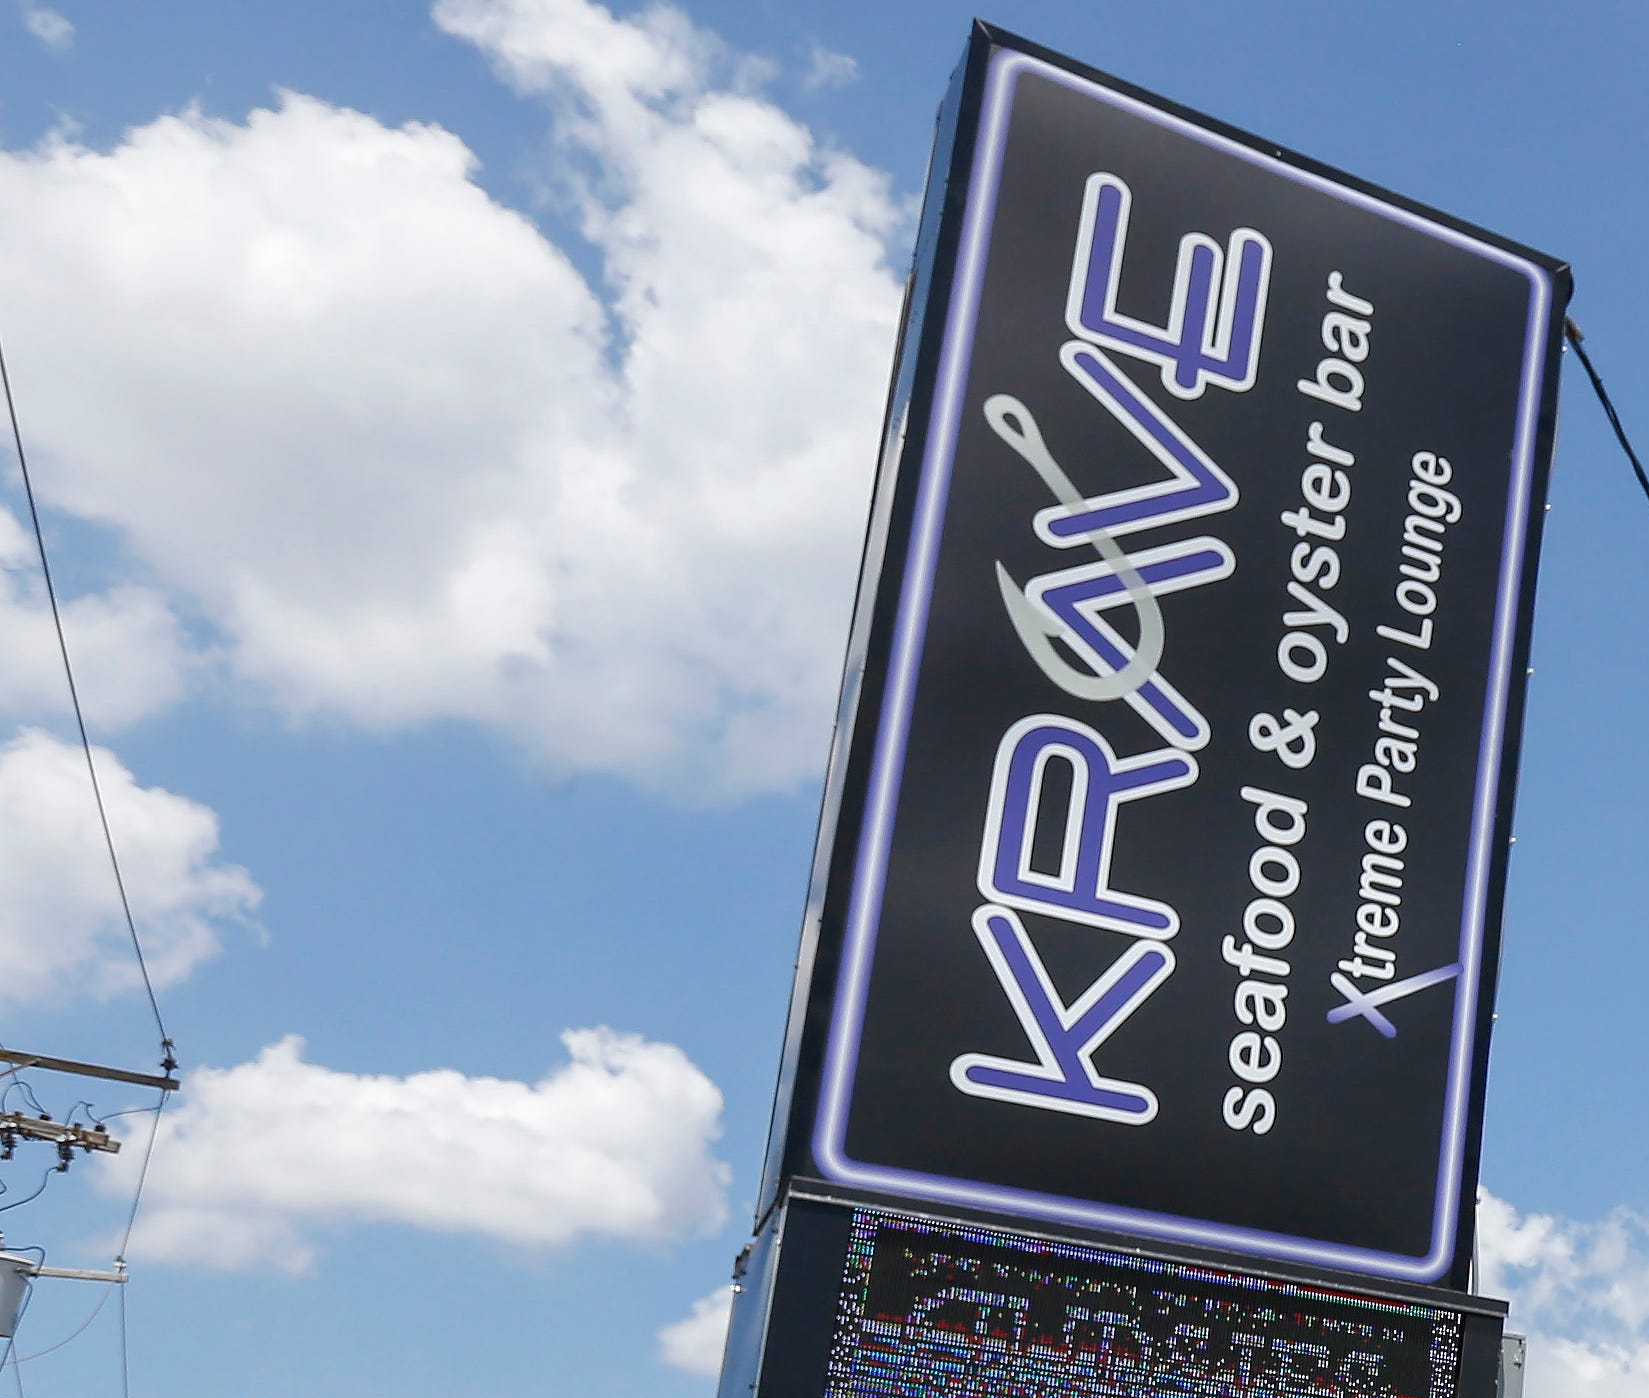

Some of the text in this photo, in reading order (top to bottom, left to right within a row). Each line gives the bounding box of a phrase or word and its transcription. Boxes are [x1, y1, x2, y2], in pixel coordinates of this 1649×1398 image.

[949, 172, 1273, 1125] KRAVE
[1222, 271, 1374, 1135] seafood & oyster bar
[1327, 451, 1464, 1037] Xtreme Party Lounge
